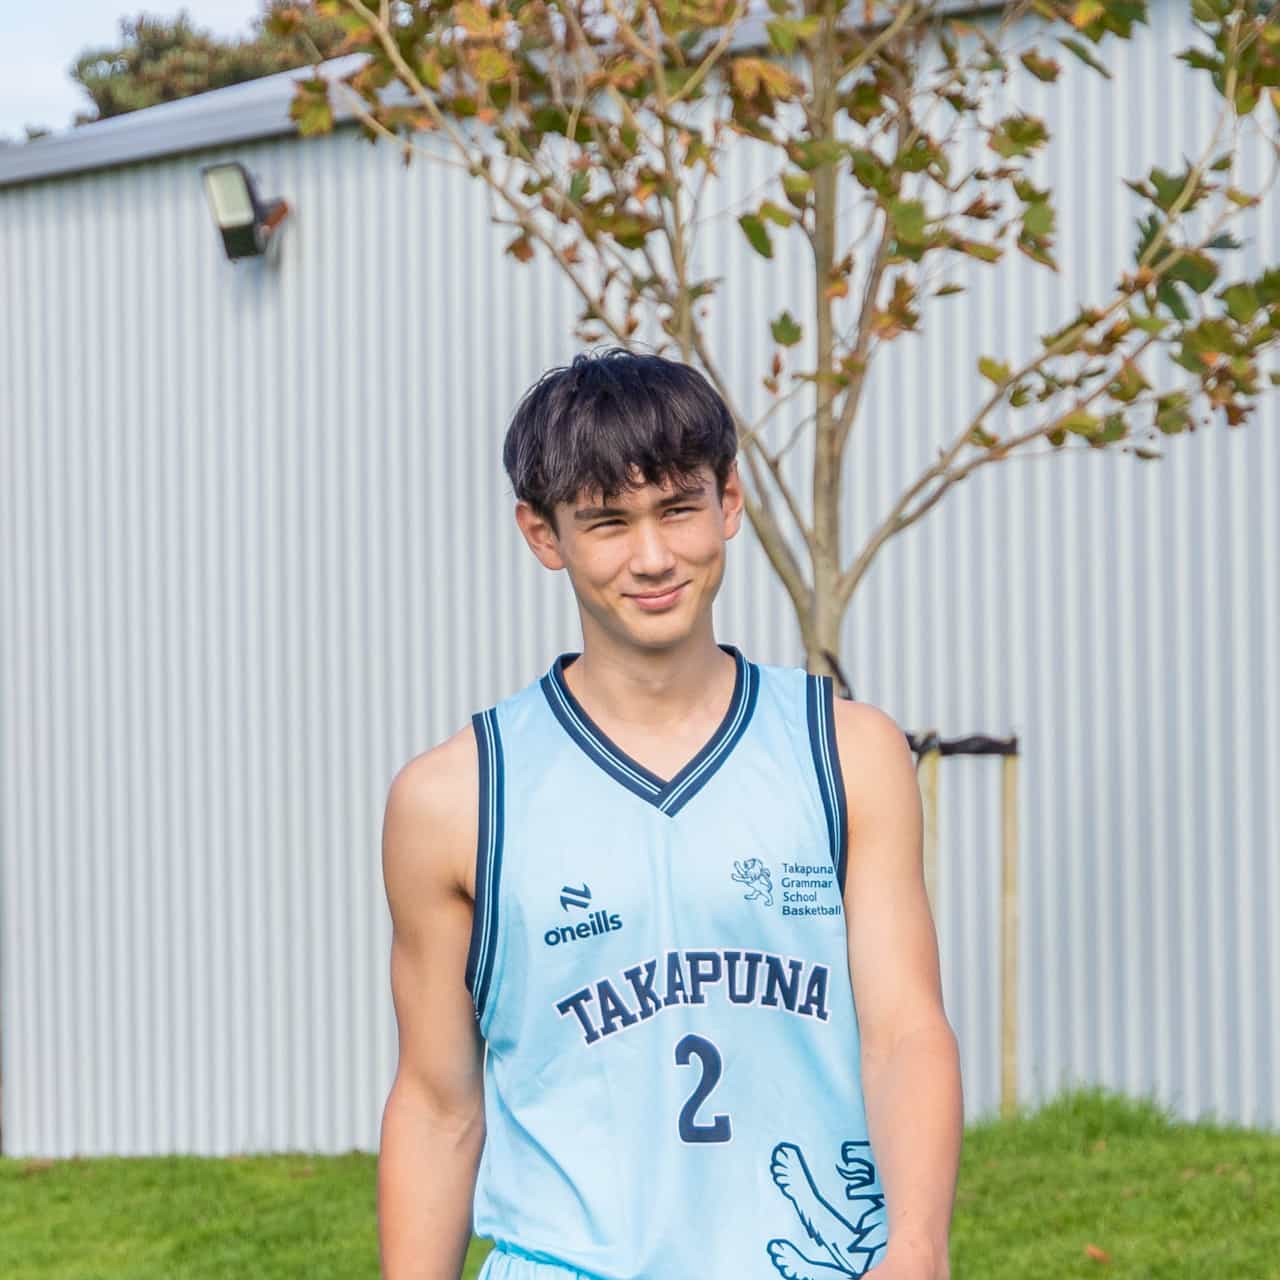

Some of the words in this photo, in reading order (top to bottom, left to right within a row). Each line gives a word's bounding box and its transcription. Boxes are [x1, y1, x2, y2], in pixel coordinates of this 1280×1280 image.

[781, 862, 834, 876] Takapuna
[781, 877, 833, 888] Grammar
[783, 891, 817, 902] School
[782, 905, 841, 916] Basketball
[554, 949, 831, 1046] TAKAPUNA
[674, 1033, 732, 1143] 2
